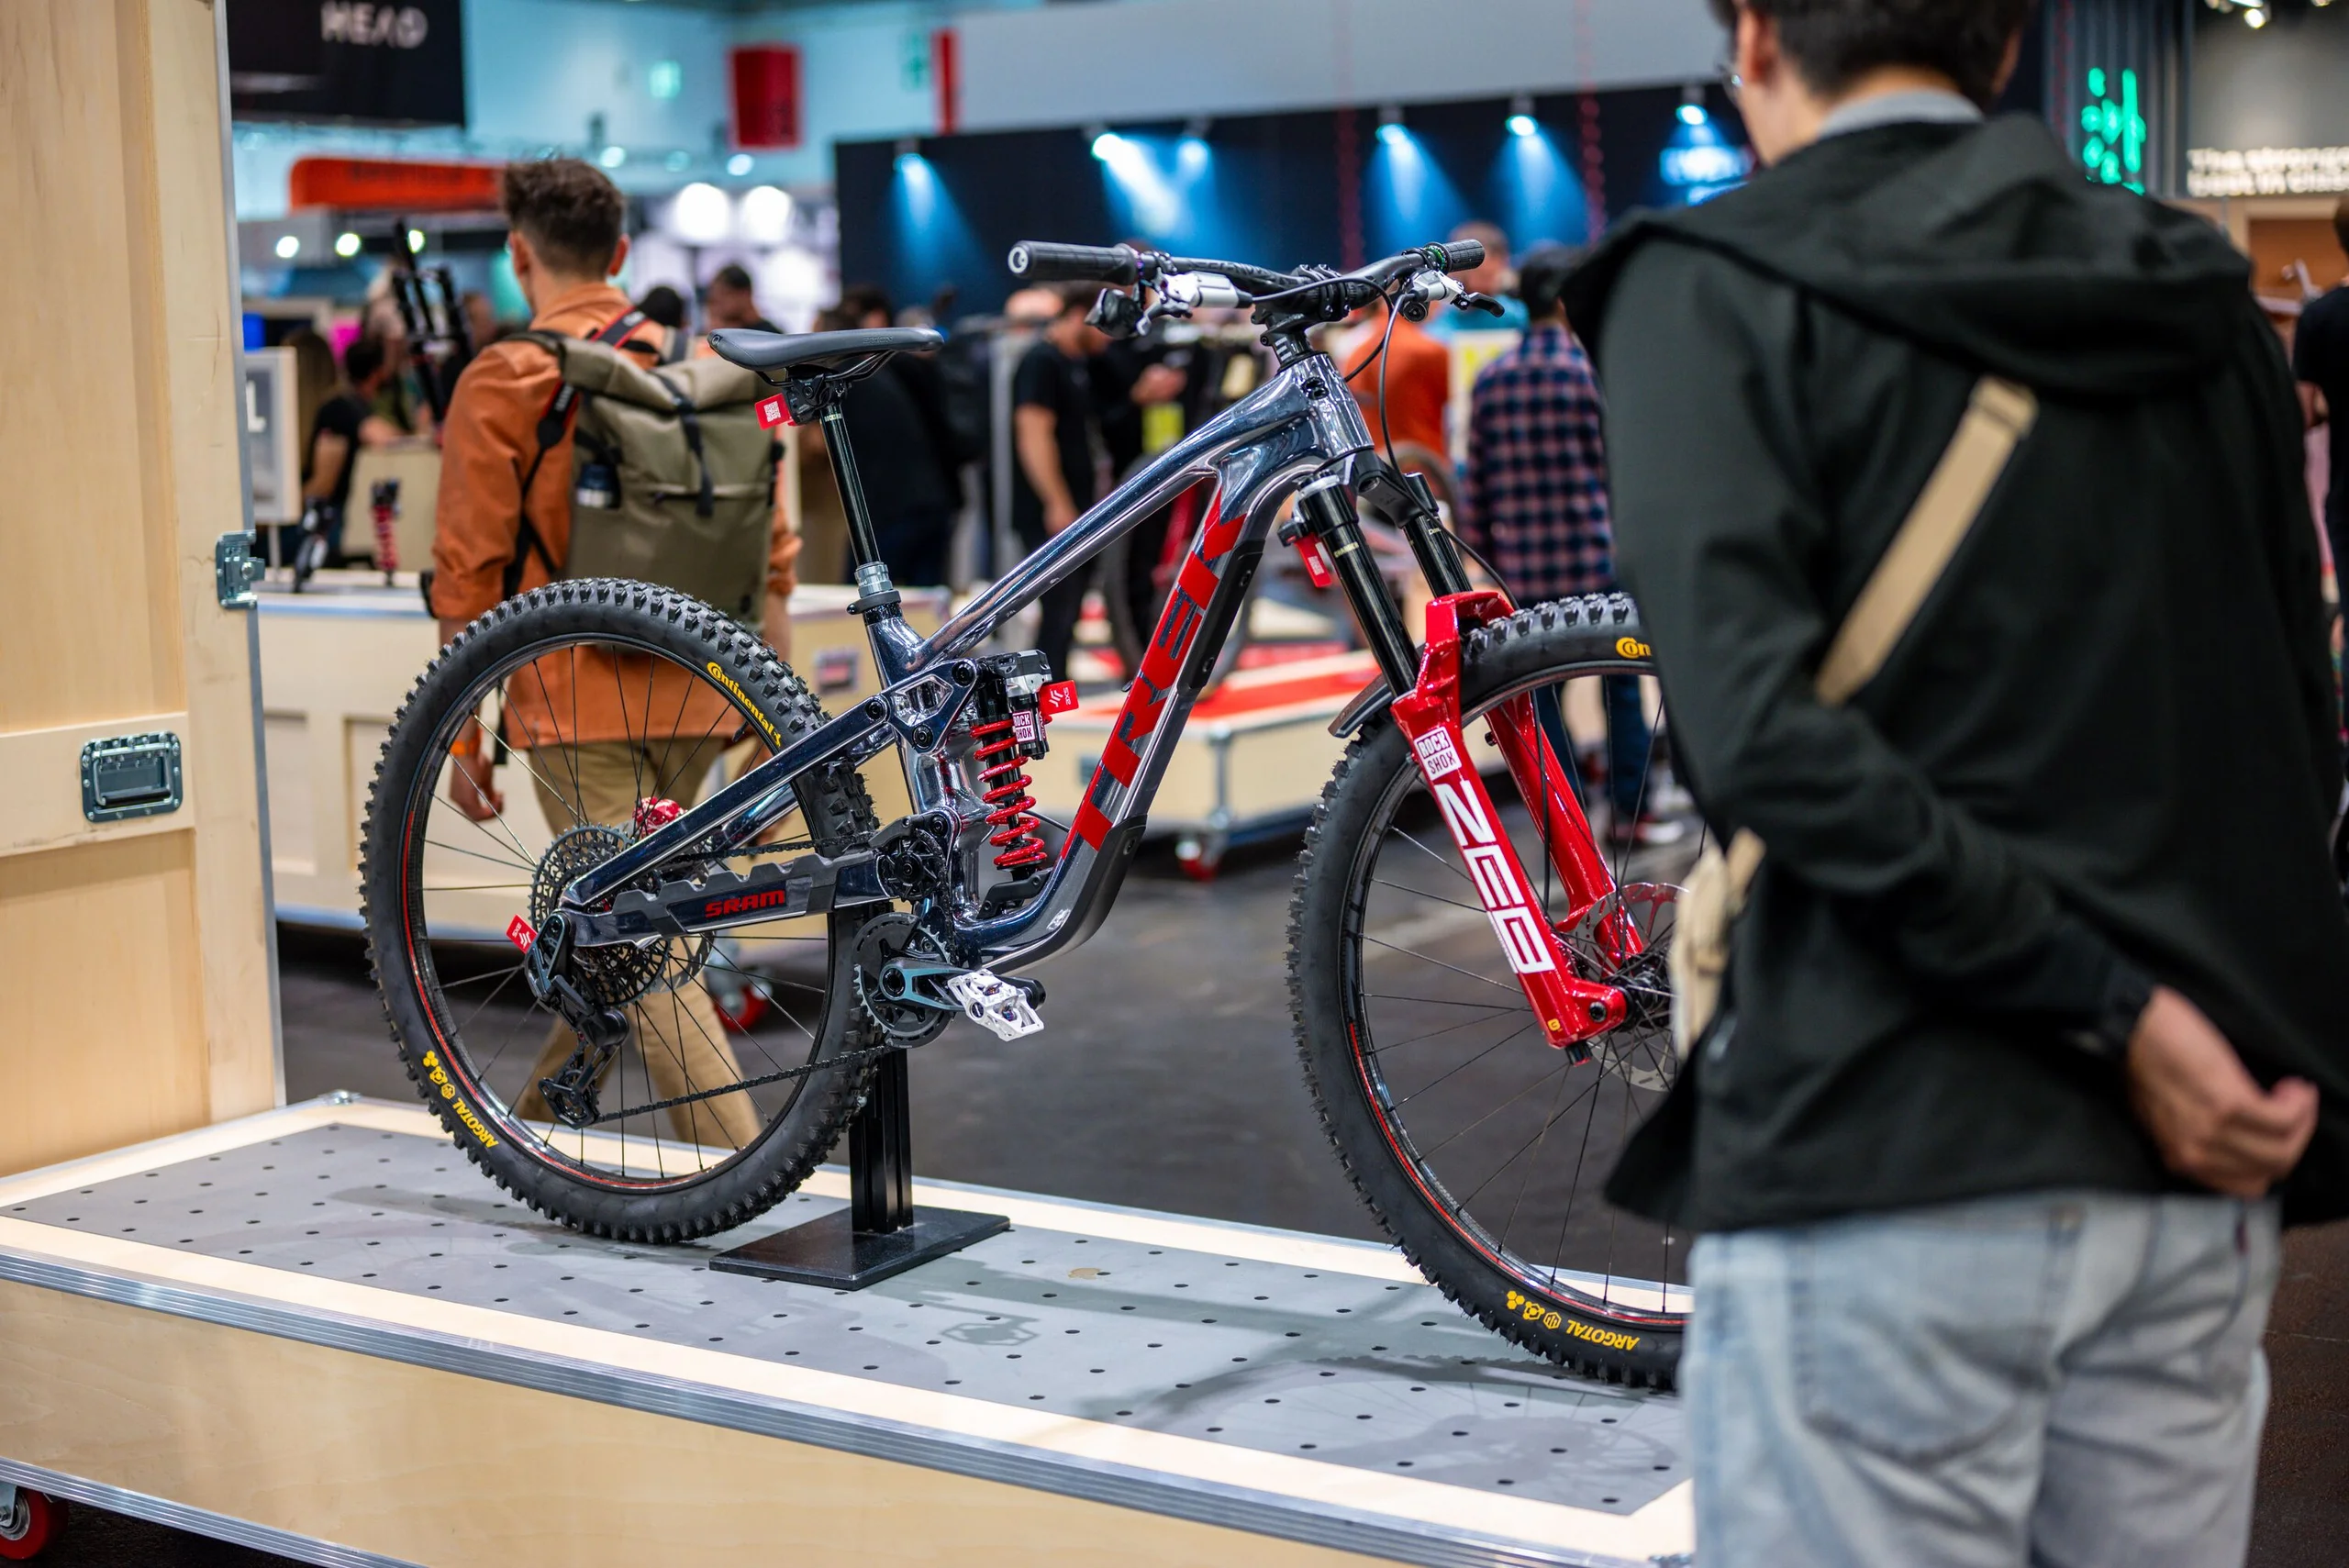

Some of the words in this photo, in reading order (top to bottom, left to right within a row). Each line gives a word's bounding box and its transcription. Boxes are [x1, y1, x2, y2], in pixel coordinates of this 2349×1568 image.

[1061, 486, 1247, 861] TREK
[707, 662, 775, 735] Continental
[1012, 715, 1032, 727] ROCK
[1016, 728, 1033, 740] SHOX
[1417, 730, 1449, 758] ROCK
[1428, 751, 1457, 774] SHOX
[1434, 780, 1556, 973] ZEB
[705, 889, 785, 917] SRAM
[452, 1096, 499, 1148] ARGOTAL
[1565, 1319, 1641, 1351] ARGOTAL
